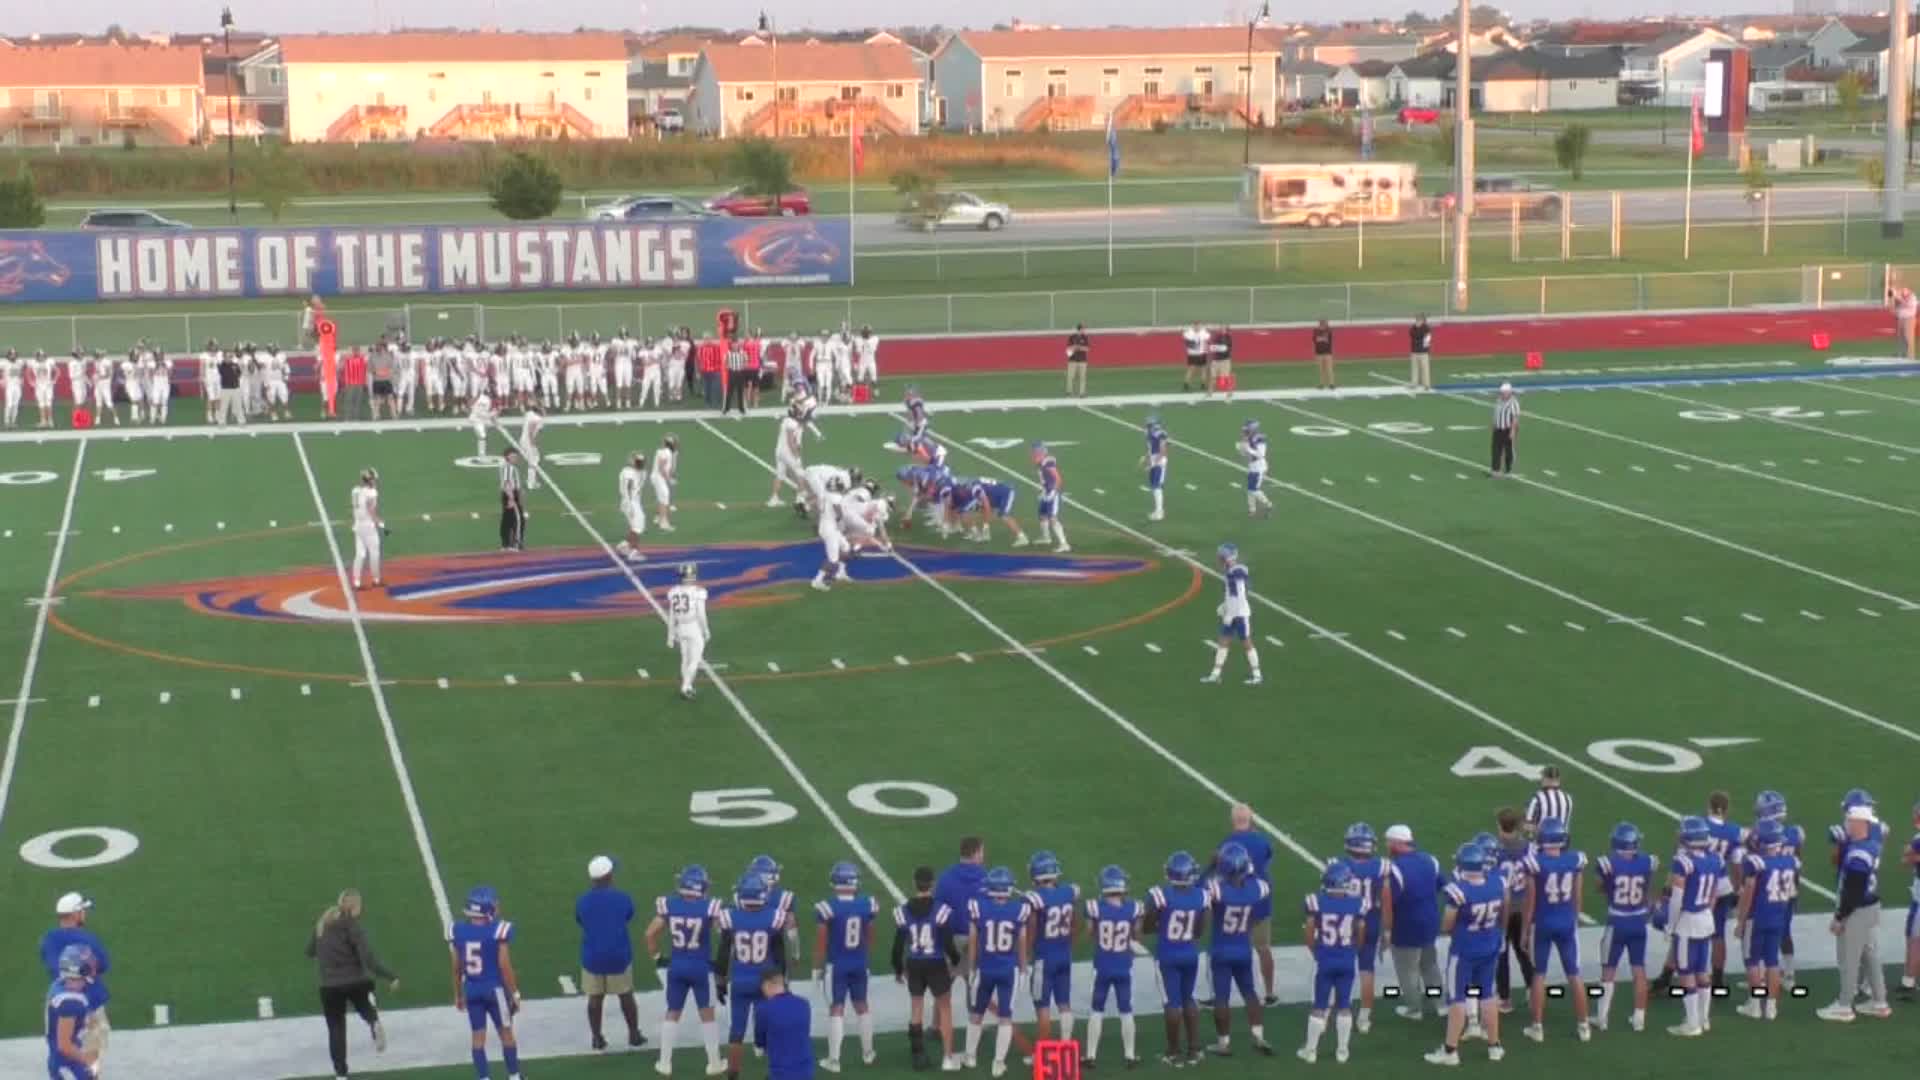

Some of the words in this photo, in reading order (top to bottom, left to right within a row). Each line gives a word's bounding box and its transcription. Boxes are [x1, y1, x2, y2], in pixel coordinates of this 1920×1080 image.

[100, 235, 242, 294] HOME
[258, 234, 319, 291] OF
[335, 233, 424, 290] THE
[440, 227, 695, 287] MUSTANGS
[671, 593, 690, 615] 23
[1544, 871, 1573, 904] 44
[1614, 875, 1645, 905] 26
[1694, 872, 1715, 906] 11
[1766, 868, 1797, 902] 43
[1045, 904, 1074, 938] 23
[1167, 909, 1196, 942] 61
[1222, 904, 1252, 934] 51
[1321, 912, 1353, 947] 54
[1467, 899, 1502, 932] 75
[669, 916, 703, 950] 57
[734, 930, 769, 964] 68
[845, 917, 862, 949] 8
[909, 923, 936, 954] 14
[985, 920, 1014, 952] 16
[1098, 920, 1131, 952] 82
[465, 941, 484, 976] 5
[1041, 1045, 1077, 1080] 50
